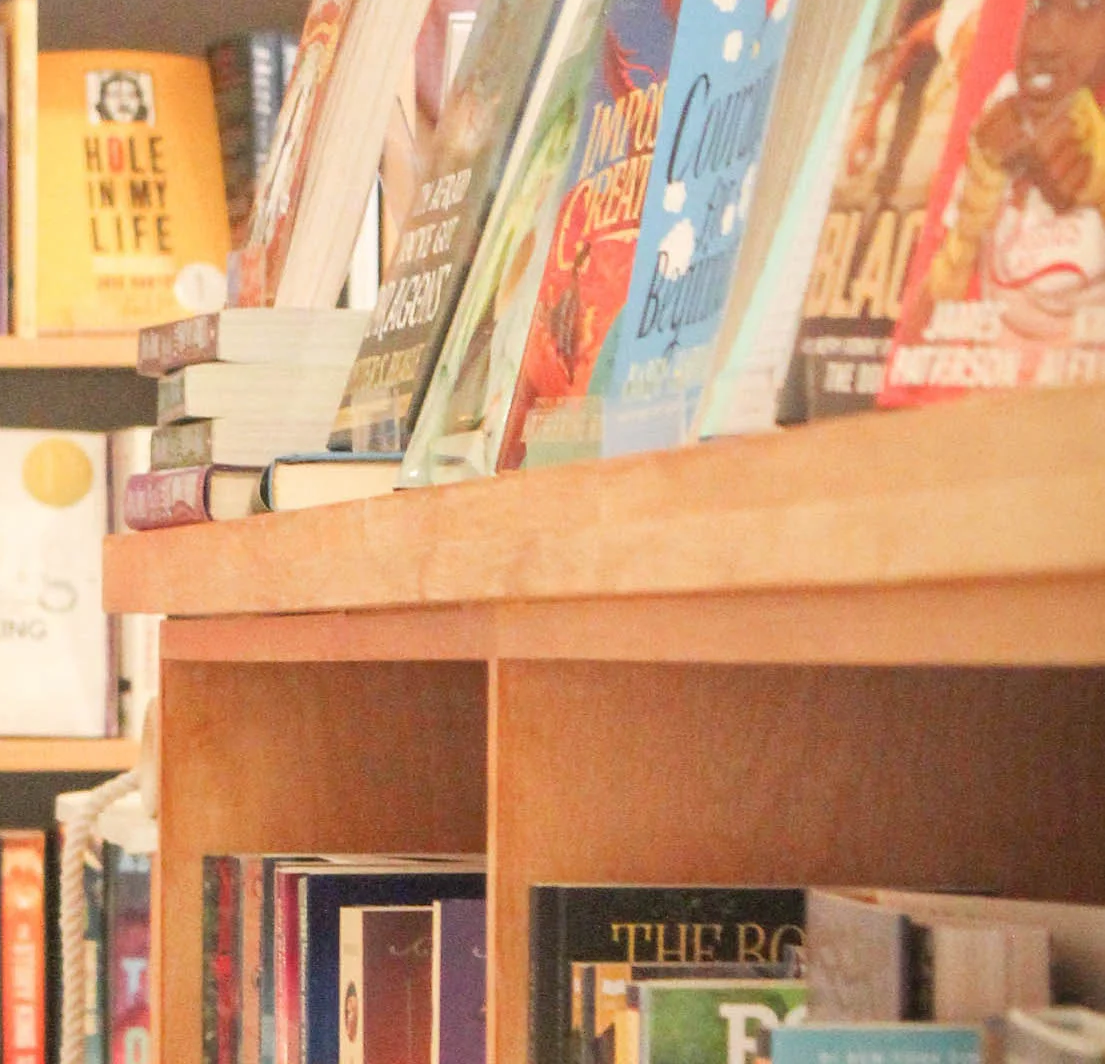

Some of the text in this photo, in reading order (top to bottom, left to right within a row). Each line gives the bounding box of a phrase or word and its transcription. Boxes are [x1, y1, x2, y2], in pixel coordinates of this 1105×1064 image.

[83, 135, 167, 174] HOLE
[87, 179, 168, 209] IN MY
[89, 214, 174, 253] LIFE
[611, 922, 724, 962] THE
